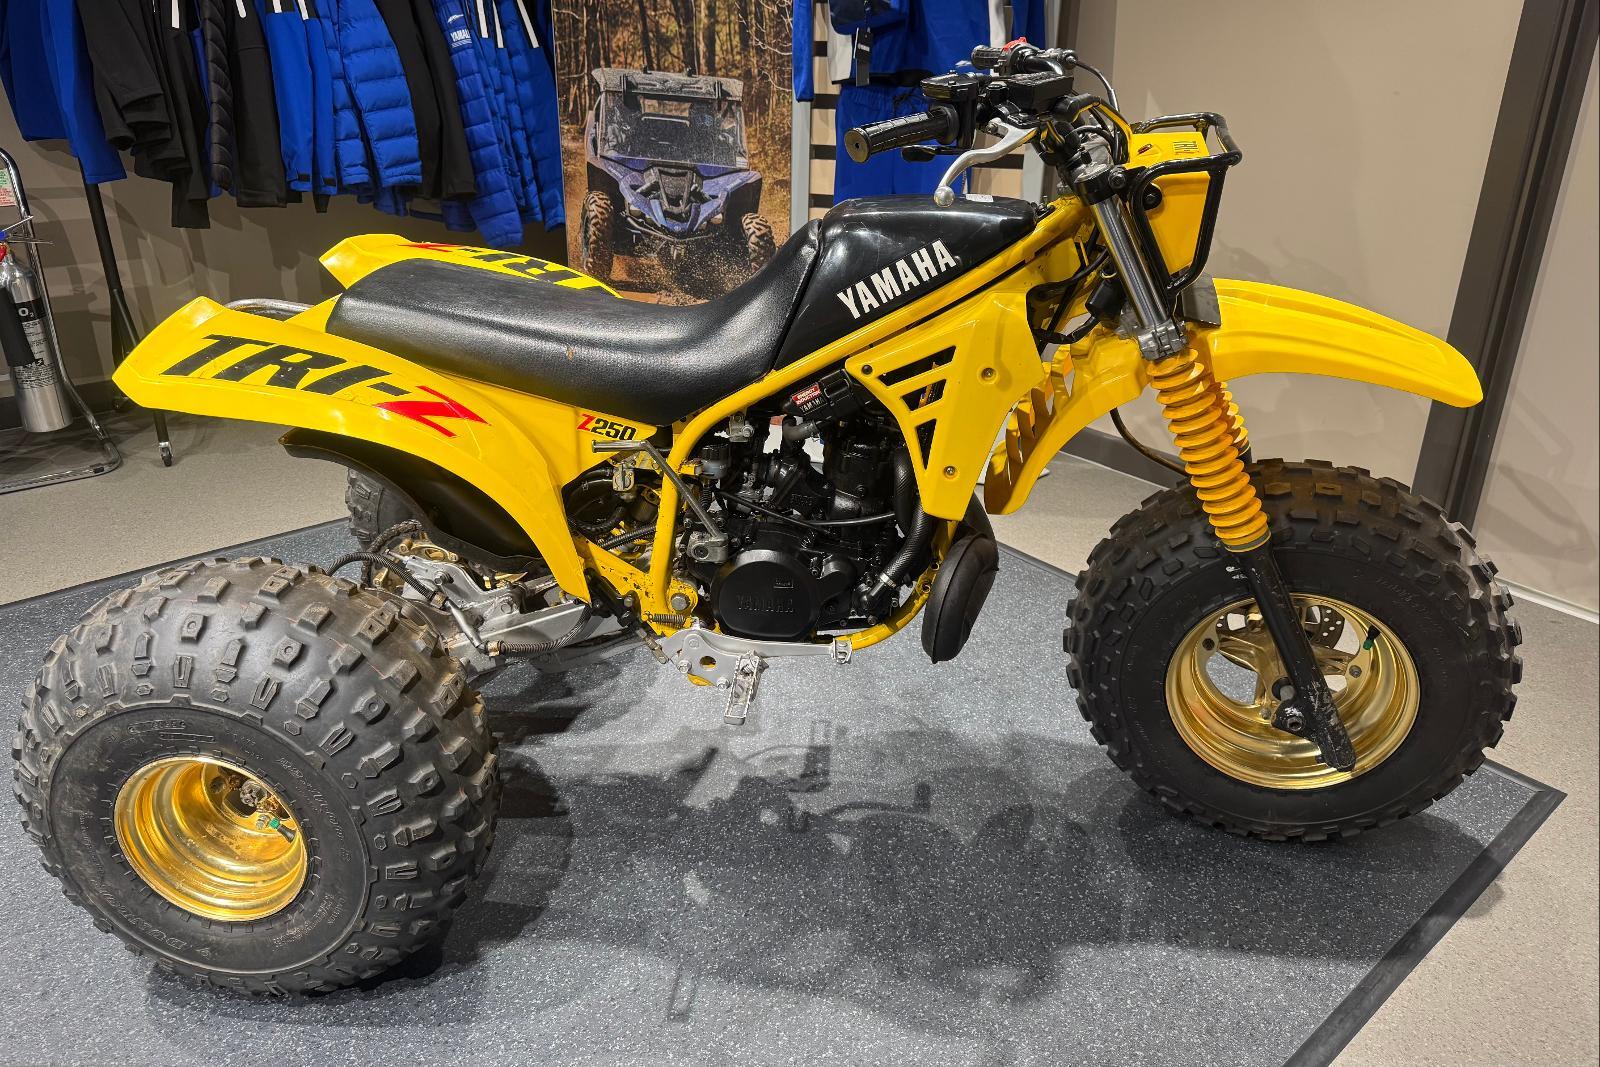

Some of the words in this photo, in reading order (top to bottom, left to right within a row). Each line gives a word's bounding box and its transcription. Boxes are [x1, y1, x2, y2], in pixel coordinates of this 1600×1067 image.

[836, 239, 957, 320] YAMAHA
[159, 333, 492, 438] TRI-Z
[800, 397, 828, 413] YAMAHA
[576, 413, 637, 441] Z250
